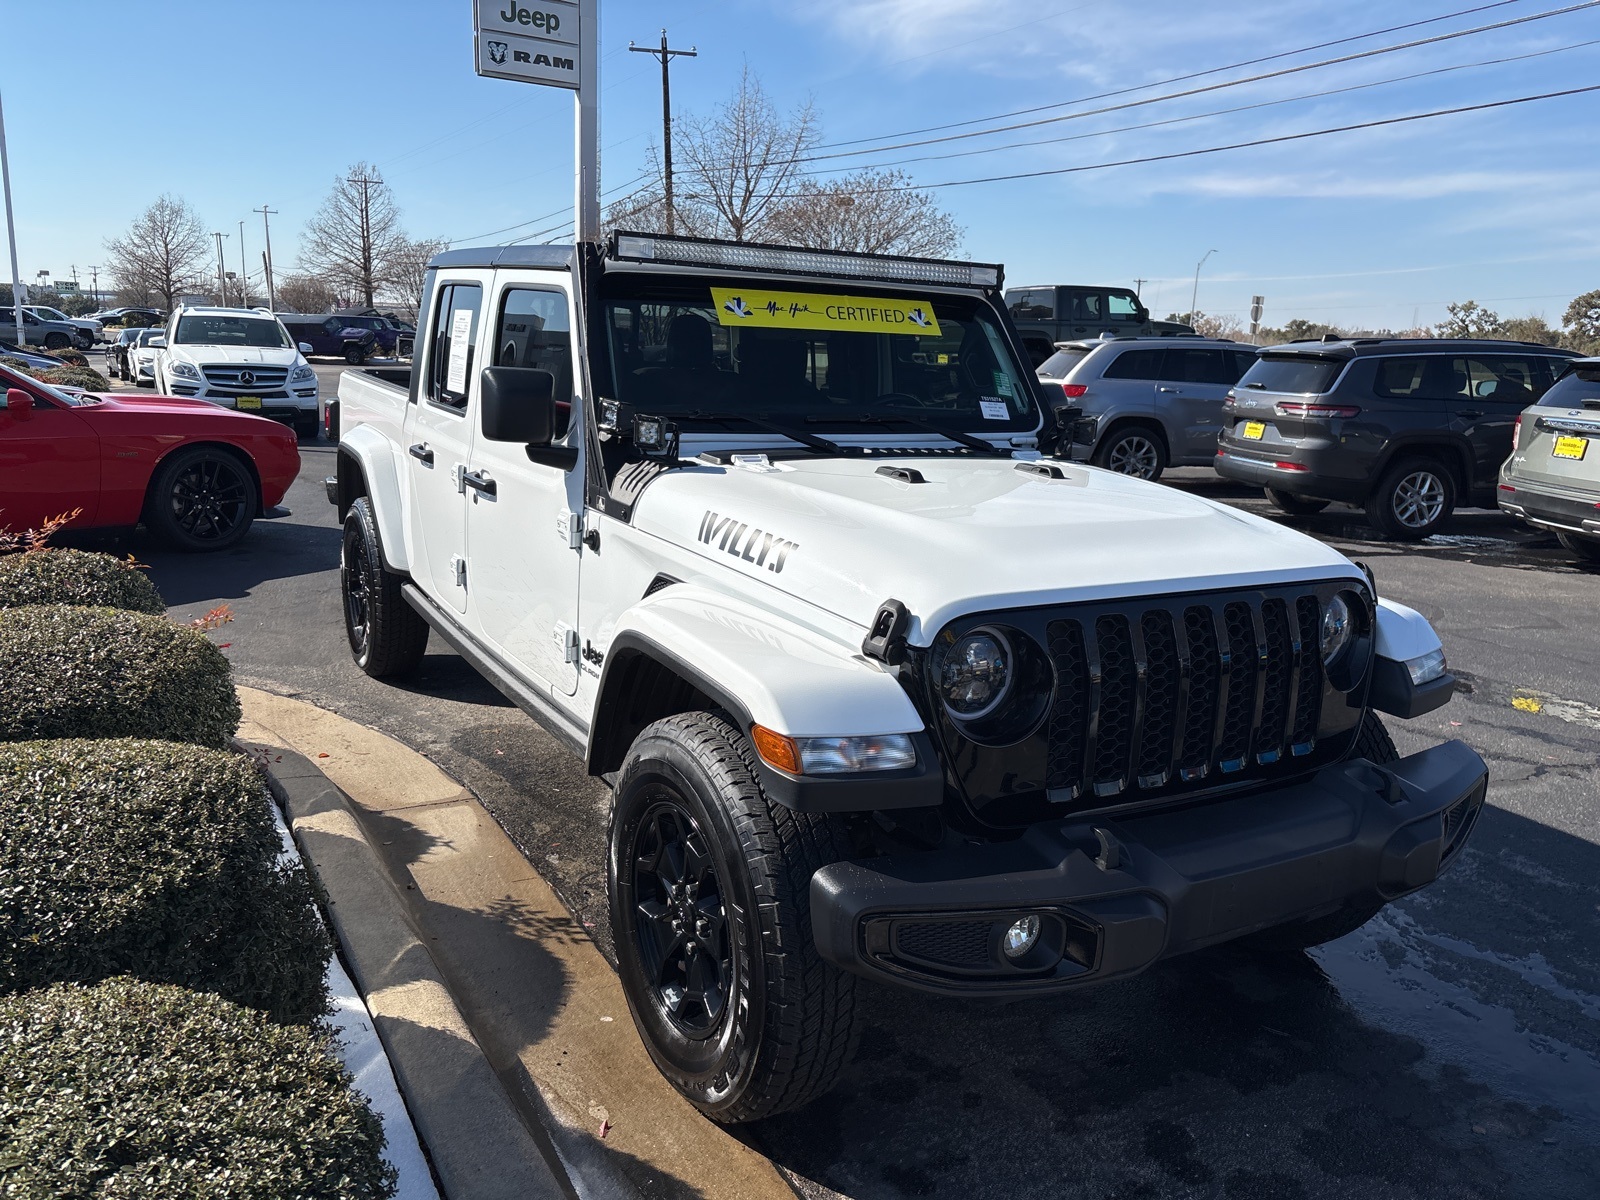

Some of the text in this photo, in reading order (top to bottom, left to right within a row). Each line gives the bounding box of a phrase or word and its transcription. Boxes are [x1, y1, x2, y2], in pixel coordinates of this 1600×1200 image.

[500, 0, 560, 34] Jeep
[513, 50, 574, 71] RAM
[825, 305, 905, 323] CERTIFIED
[697, 509, 800, 574] WILLYS
[582, 638, 605, 669] Jee
